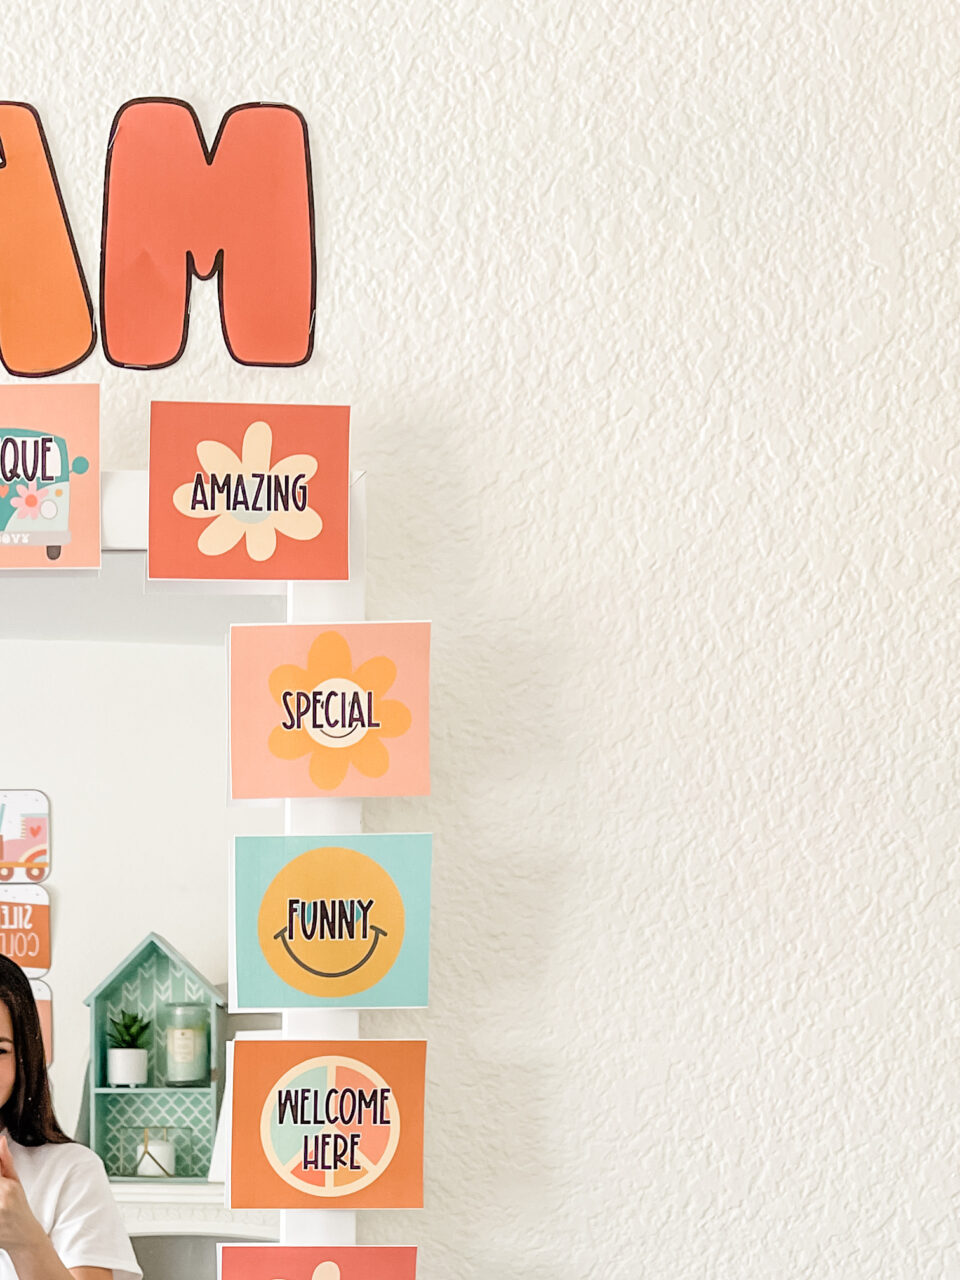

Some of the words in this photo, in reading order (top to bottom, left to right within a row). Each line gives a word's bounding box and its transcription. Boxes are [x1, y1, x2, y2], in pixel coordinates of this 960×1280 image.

[191, 473, 307, 512] AMAZING
[282, 691, 380, 729] SPECIAL
[288, 899, 374, 940] FUNNY
[278, 1088, 390, 1125] WELCOME
[303, 1134, 361, 1170] HERE
